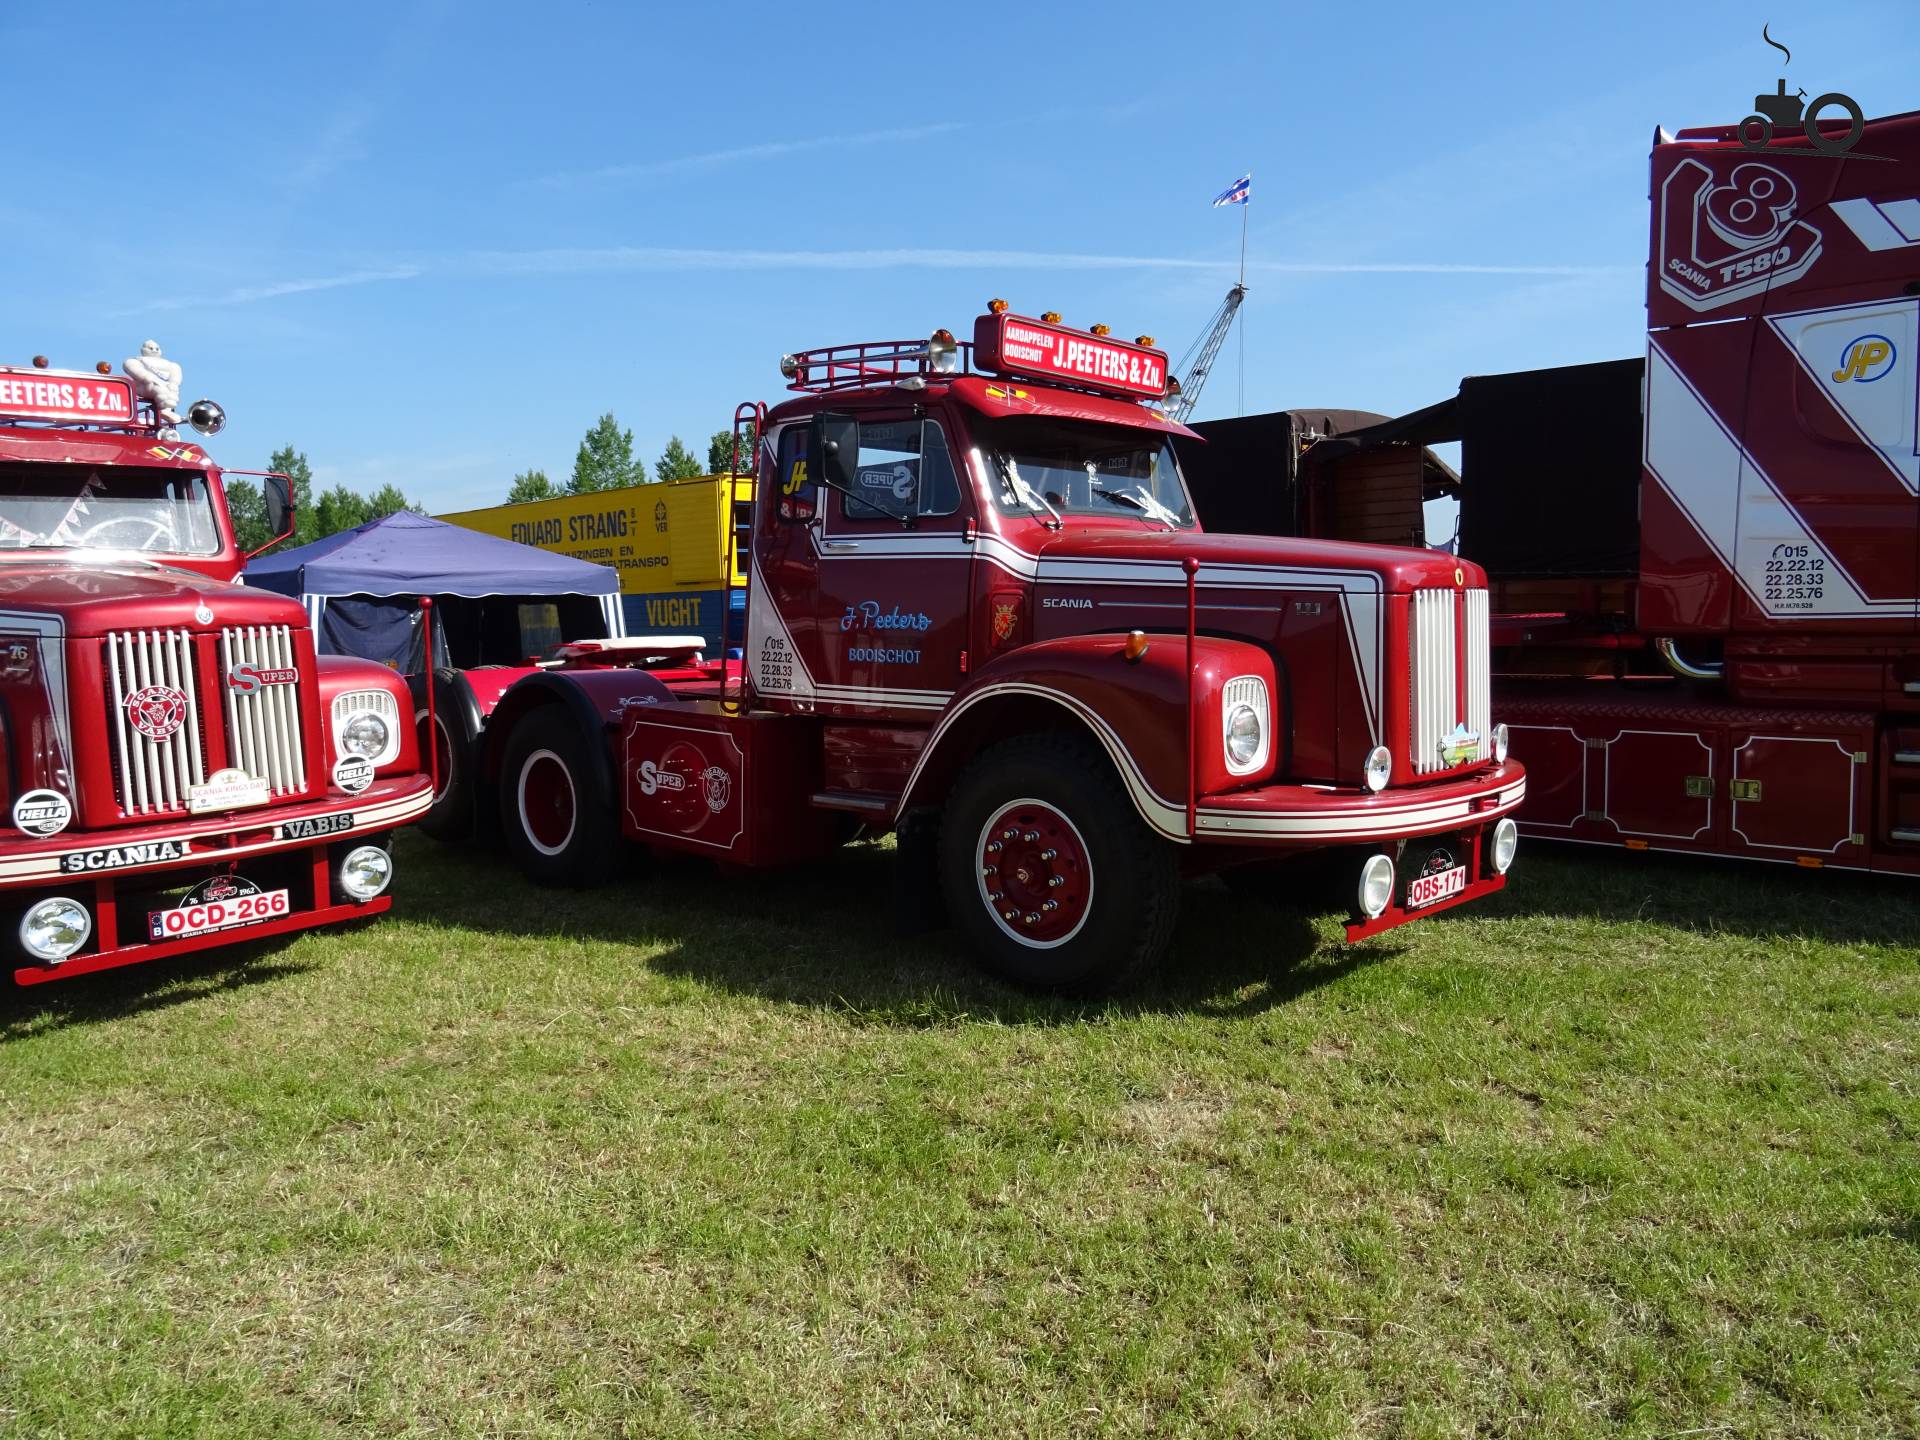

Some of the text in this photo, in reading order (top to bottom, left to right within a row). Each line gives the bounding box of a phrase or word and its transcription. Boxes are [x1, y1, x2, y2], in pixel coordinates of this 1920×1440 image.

[1719, 246, 1791, 283] T580
[1669, 258, 1712, 290] SCANIA
[1005, 326, 1054, 349] AARDAPPELEN
[1004, 342, 1043, 363] BOOISCHOT
[1128, 360, 1141, 384] &
[78, 387, 95, 410] &
[511, 518, 562, 545] EDUARD
[569, 509, 627, 542] STRANG
[619, 545, 634, 556] EN
[1784, 546, 1808, 558] 015
[1765, 559, 1824, 572] 22.22.12
[1765, 573, 1824, 586] 22.28.33
[1765, 587, 1823, 600] 22.25.76
[1043, 598, 1093, 608] SCANIA
[646, 598, 701, 627] VUGHT
[771, 638, 784, 649] 015
[9, 645, 28, 660] 76
[761, 651, 792, 663] 22.22.12
[848, 648, 920, 664] BOOISCHOT
[761, 664, 792, 676] 22.28.33
[232, 662, 294, 696] SUPER
[761, 677, 792, 689] 22.25.76
[132, 687, 182, 708] SCANIA
[137, 719, 180, 736] VABIS
[337, 765, 372, 781] HELLA
[641, 760, 682, 795] SUPER
[193, 787, 223, 797] SCANIA
[225, 784, 248, 793] KINGS
[18, 806, 67, 821] HELLA
[66, 814, 351, 872] SCANIA VABIS
[239, 887, 255, 895] 1962
[1413, 868, 1464, 903] OBS-171
[166, 893, 286, 932] OCD-266
[153, 927, 162, 936] B
